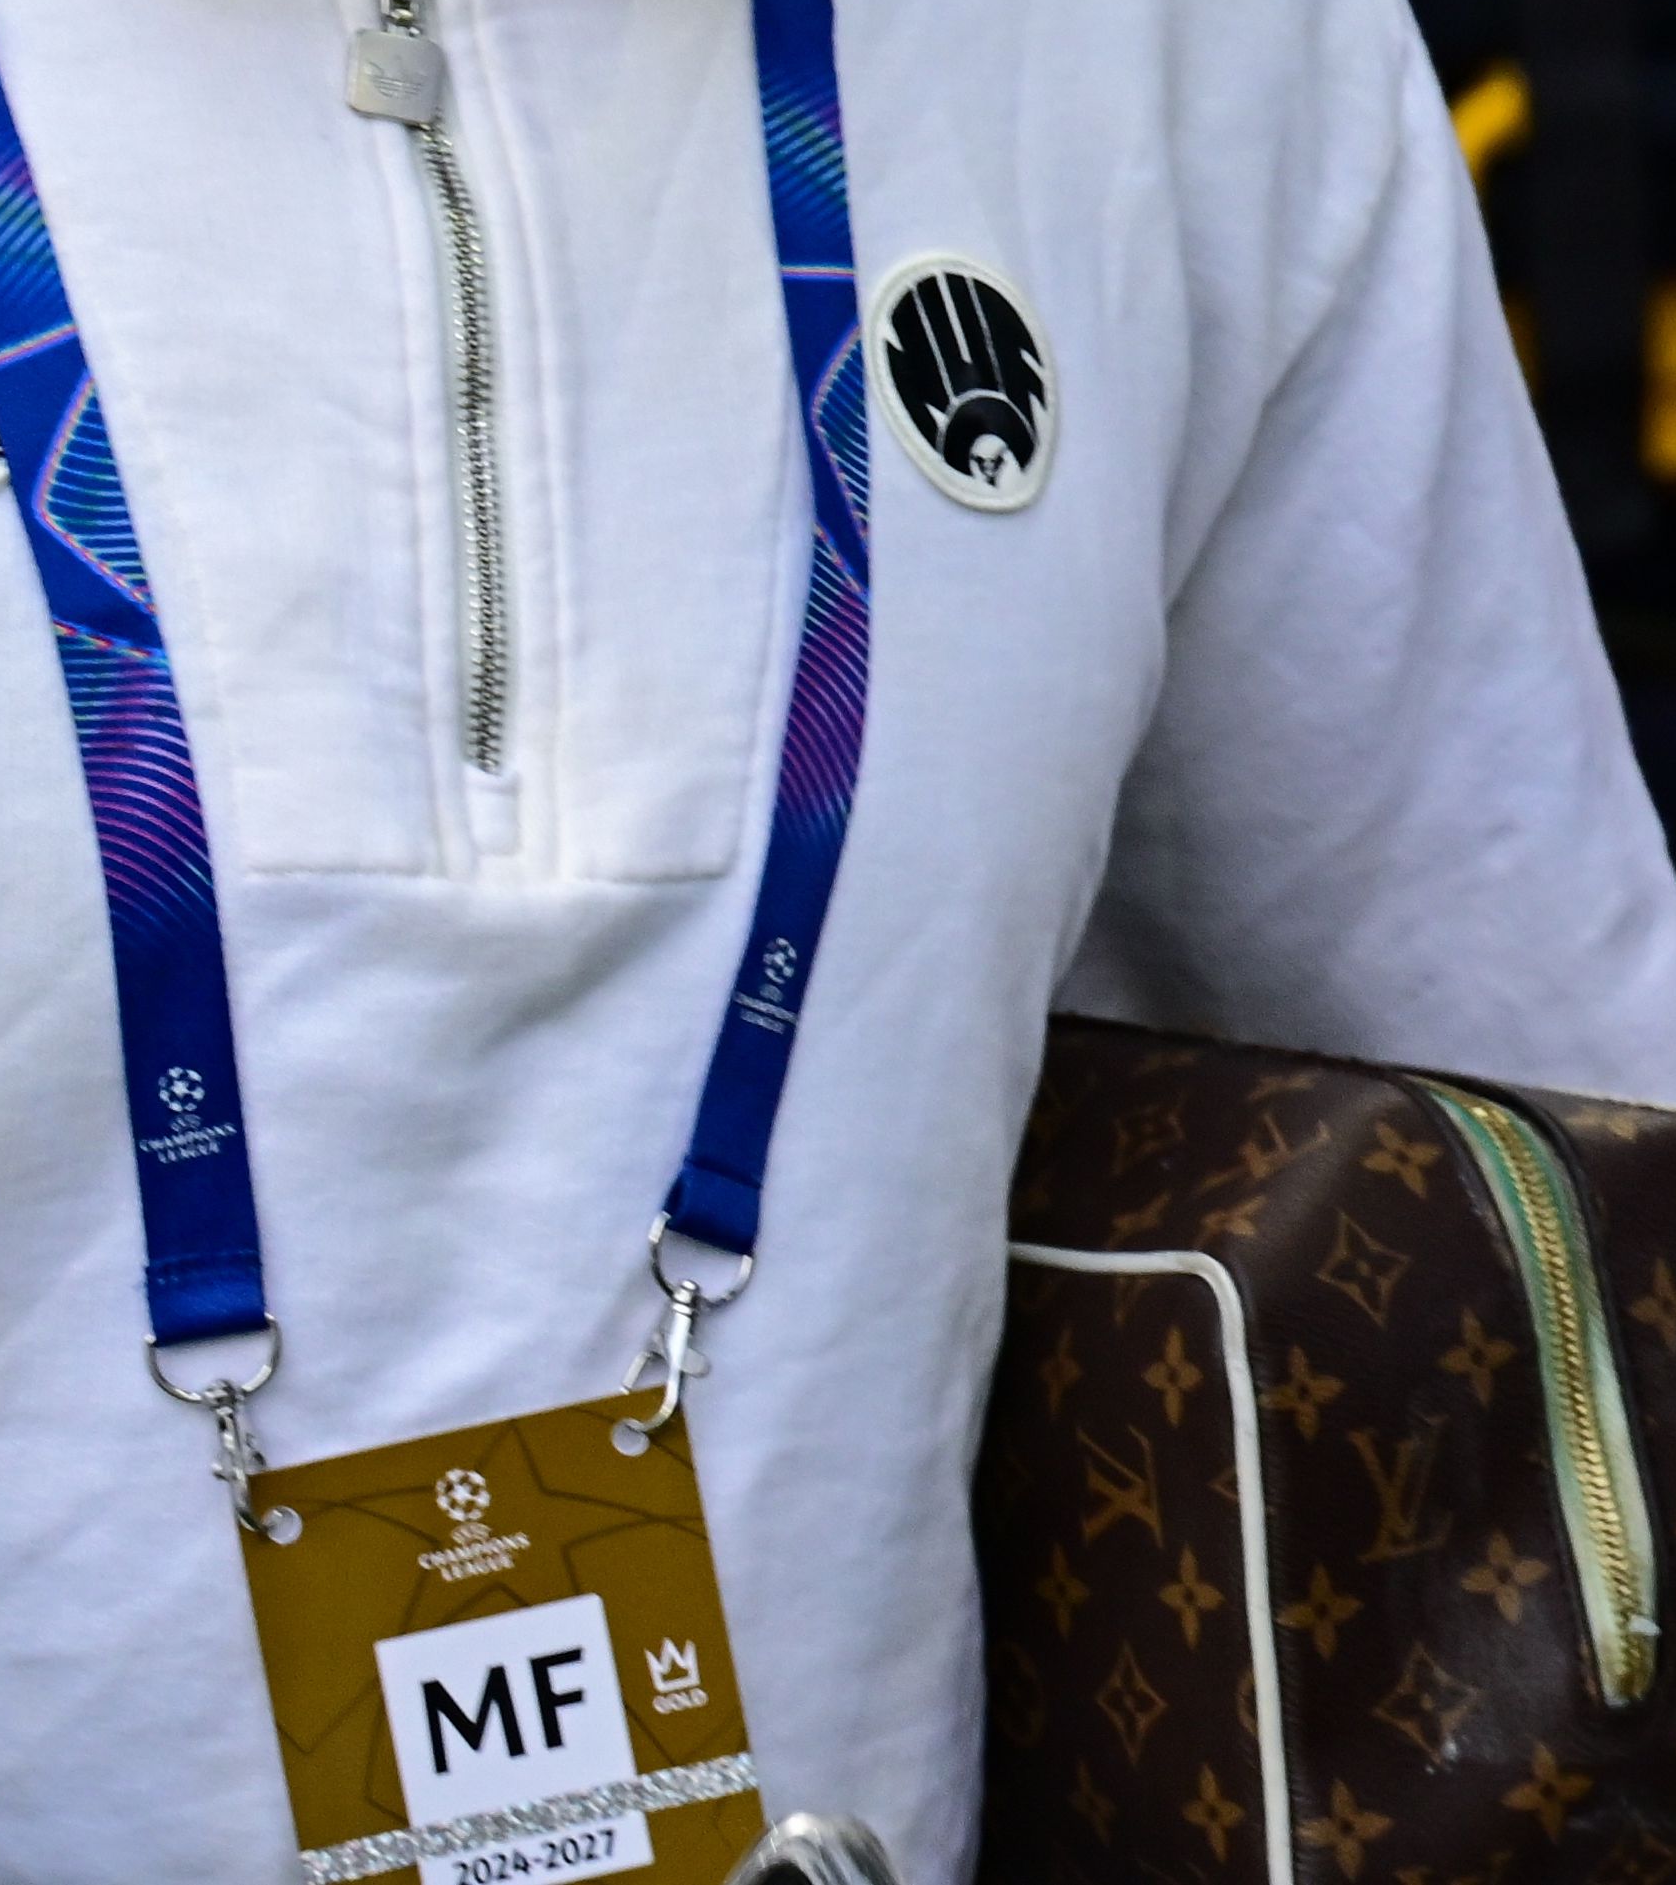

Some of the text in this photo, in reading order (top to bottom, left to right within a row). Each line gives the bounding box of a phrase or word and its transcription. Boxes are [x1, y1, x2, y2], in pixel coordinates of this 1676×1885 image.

[419, 1646, 585, 1776] MF
[652, 1687, 709, 1714] GOLD
[451, 1827, 615, 1885] 2024-2027
